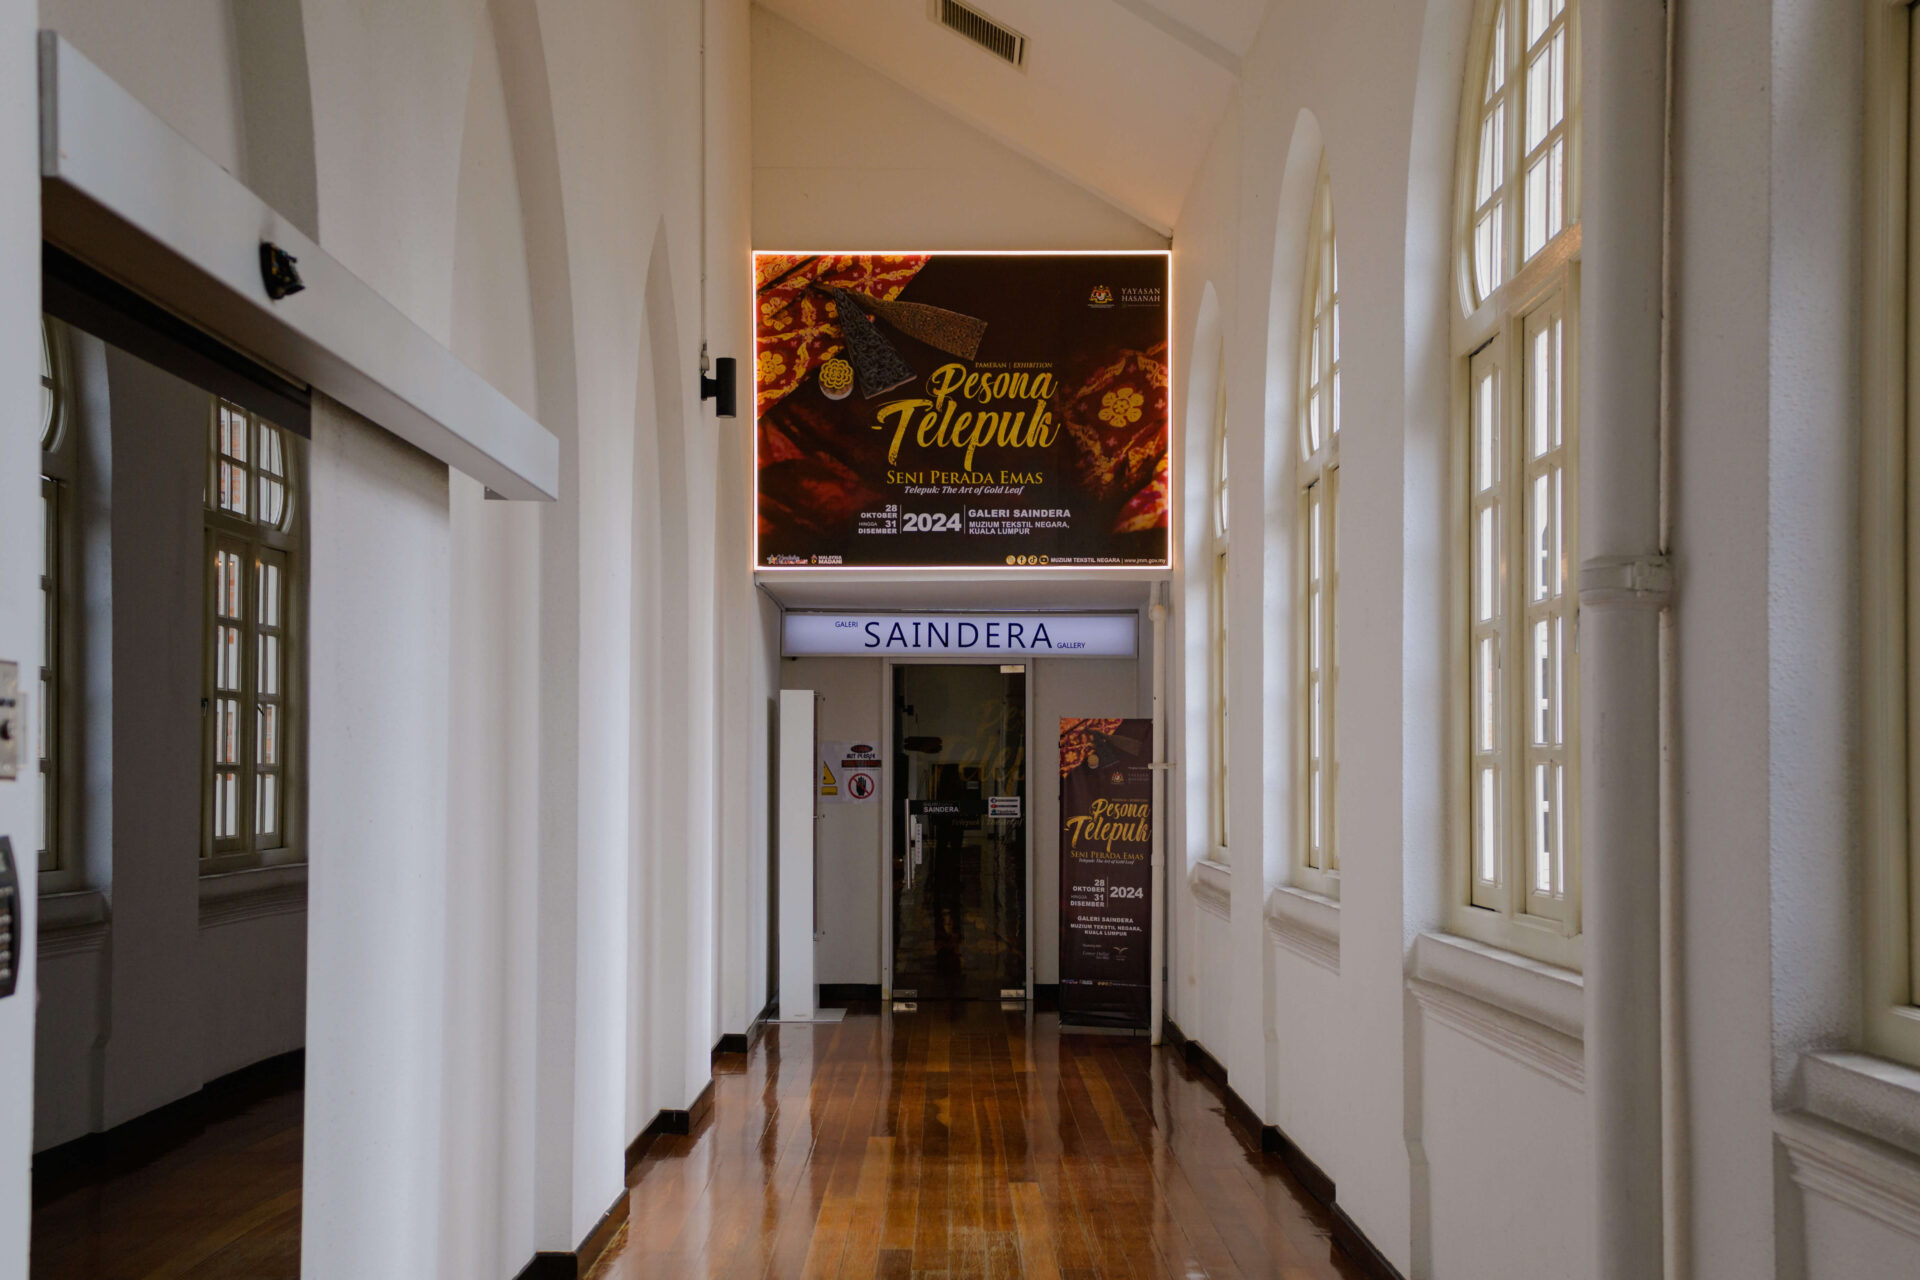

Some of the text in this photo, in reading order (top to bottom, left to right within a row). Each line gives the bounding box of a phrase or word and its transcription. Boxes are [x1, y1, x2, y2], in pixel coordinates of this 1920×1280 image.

[1121, 287, 1161, 295] YAYASAN
[926, 363, 1058, 413] Pesona
[872, 399, 1060, 472] Telepuk
[886, 470, 1043, 484] SENI PERADA EMAS
[904, 486, 1025, 495] Telepuk: The Art of Gold Leaf
[885, 504, 898, 512] 28
[968, 509, 1071, 518] GALERI SAINDERA
[885, 520, 897, 528] 31
[902, 512, 962, 532] 2024
[1035, 521, 1070, 529] NEGARA,
[864, 621, 1053, 649] SAINDERA
[1057, 641, 1086, 649] GALLERY
[1089, 798, 1151, 821] Pesona
[1064, 815, 1152, 853] Telepuk
[1071, 850, 1144, 861] SENI PERADA EMAS
[1110, 886, 1144, 899] 2024
